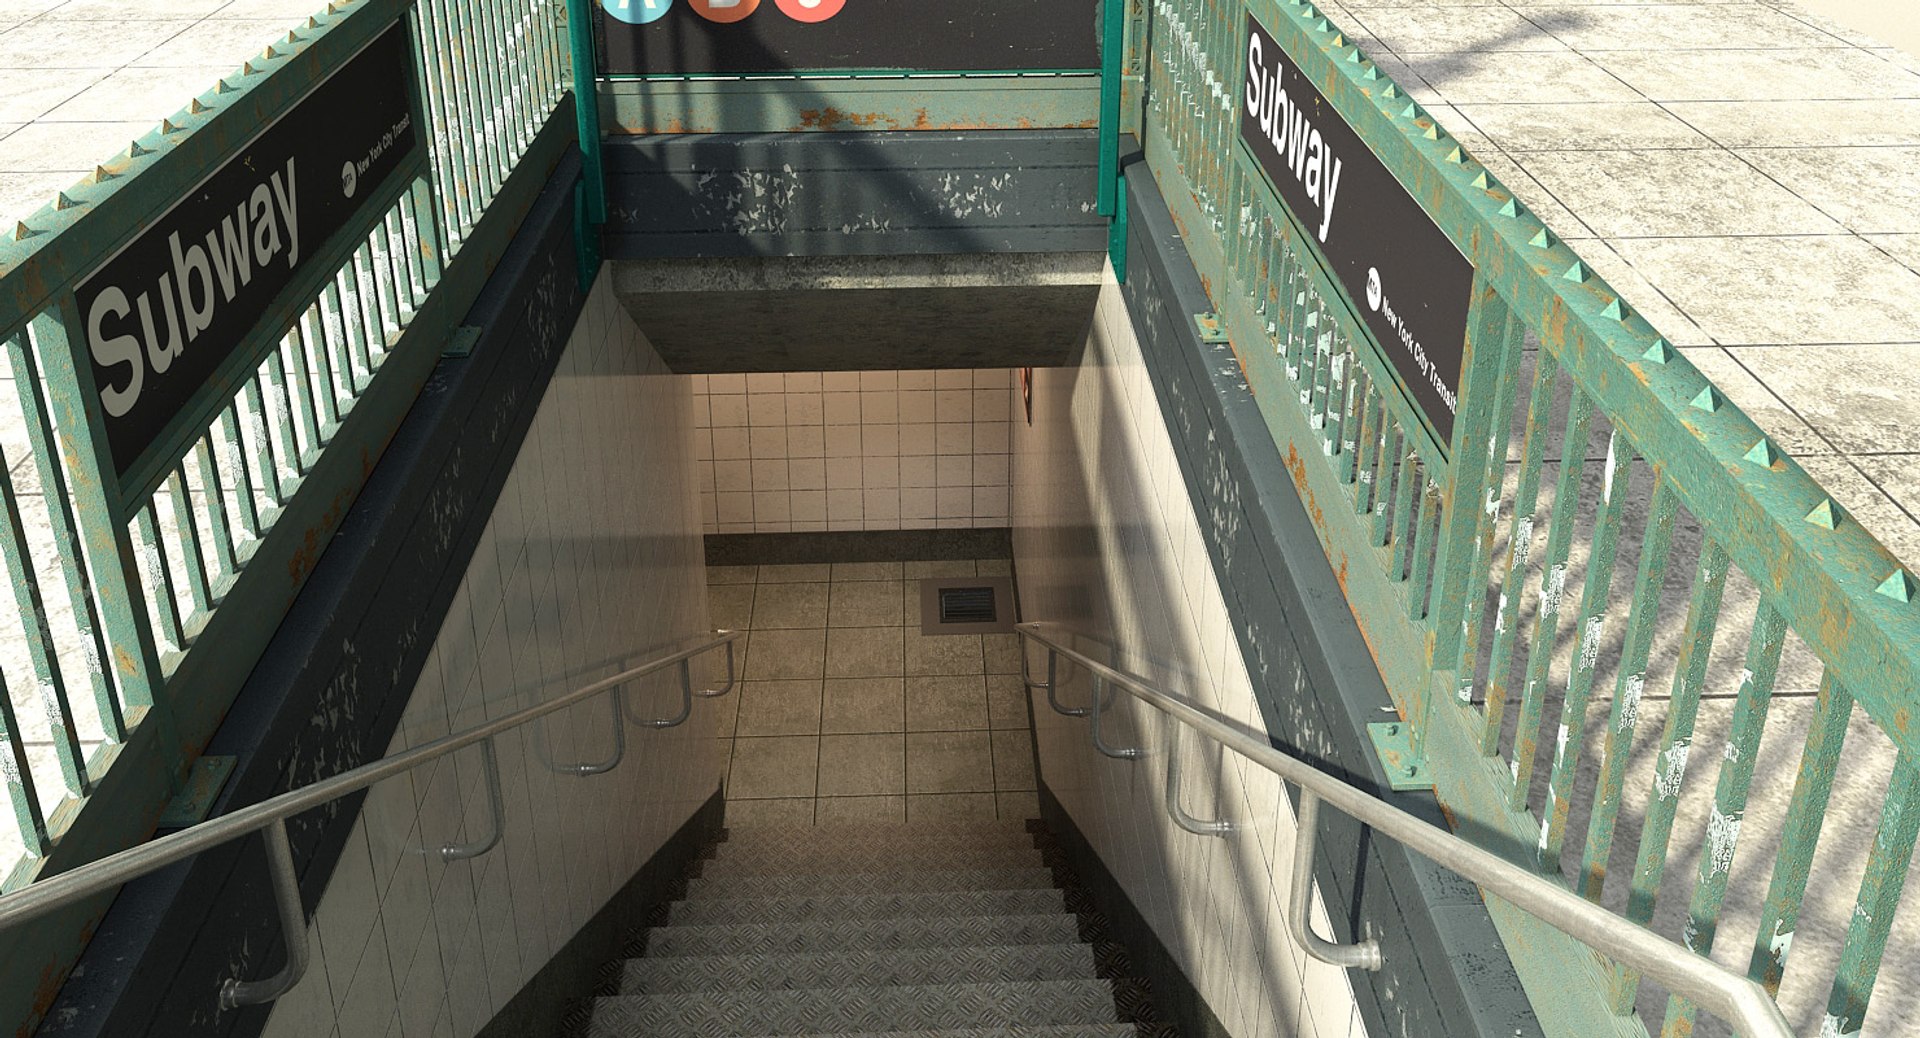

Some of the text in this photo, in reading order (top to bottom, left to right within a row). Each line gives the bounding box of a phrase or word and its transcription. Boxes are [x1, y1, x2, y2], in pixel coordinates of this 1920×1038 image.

[356, 112, 410, 177] New York City Transit
[1246, 32, 1342, 243] Subway
[88, 156, 299, 418] Subway
[1382, 295, 1457, 415] New York City Transit
